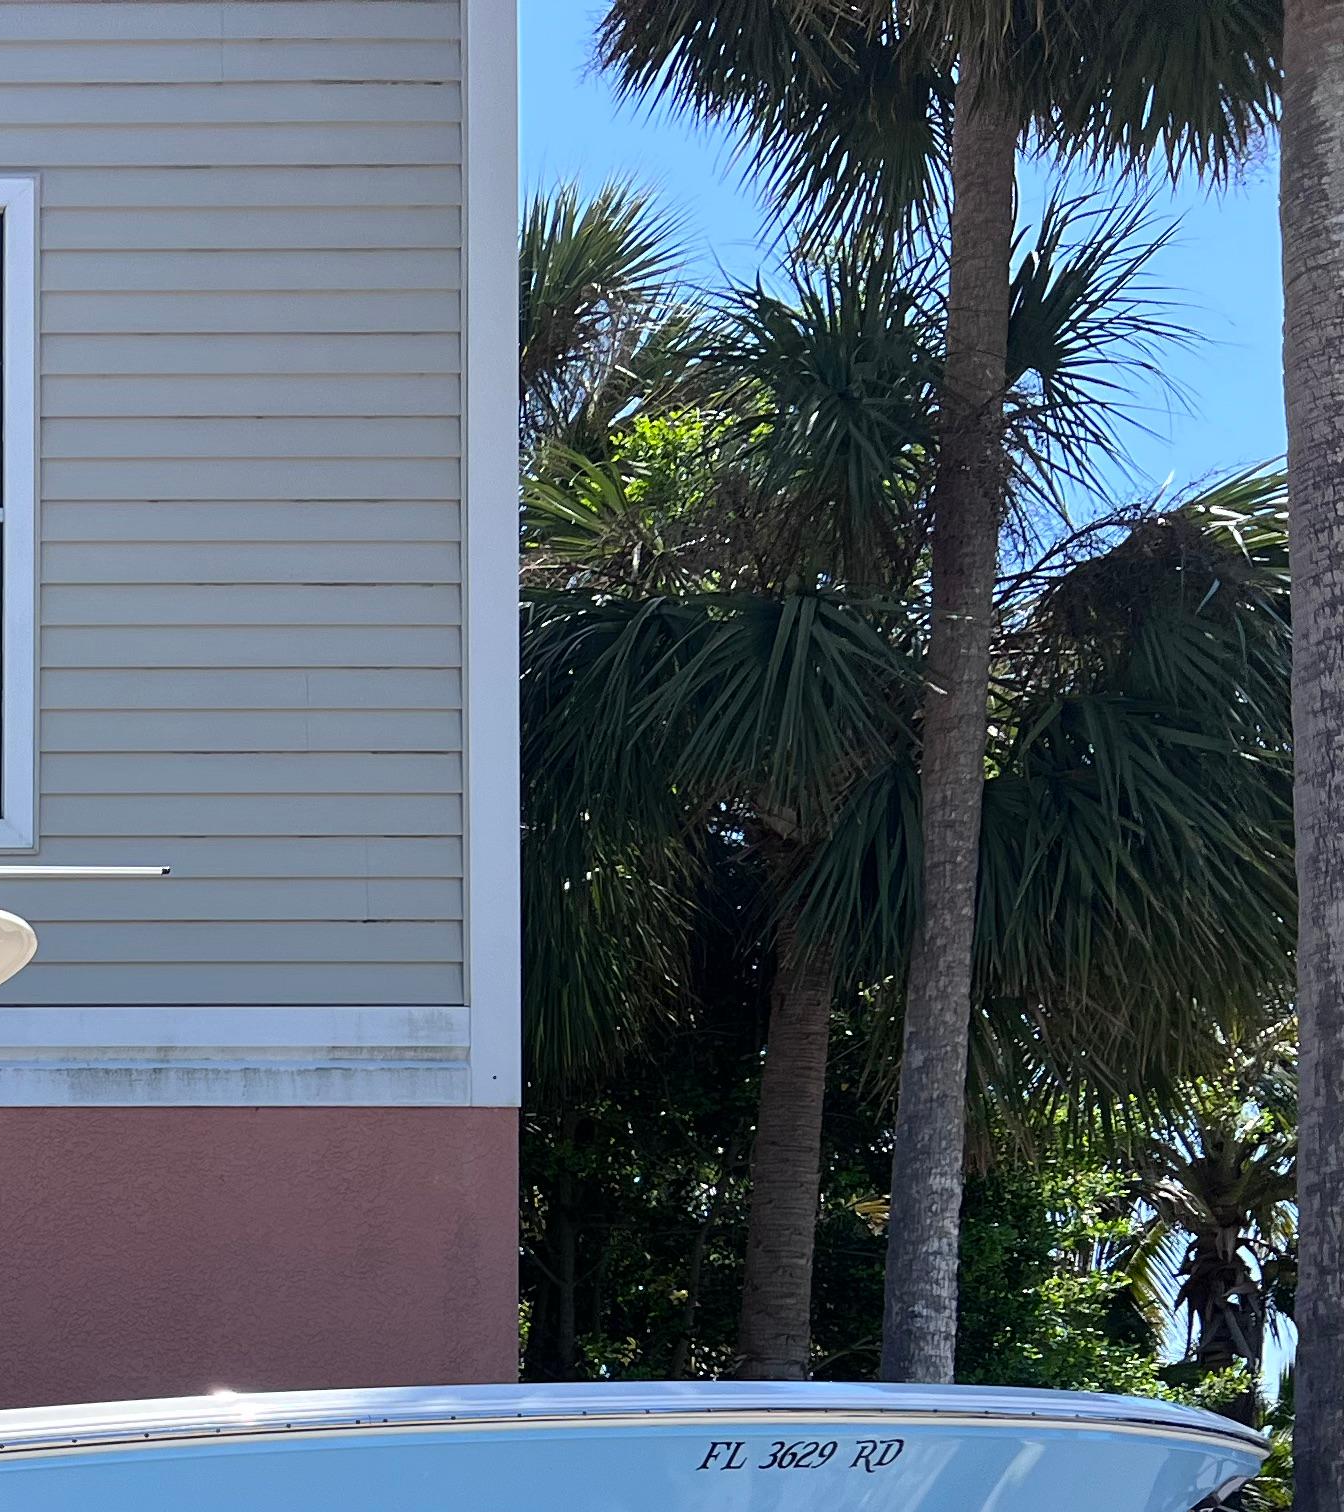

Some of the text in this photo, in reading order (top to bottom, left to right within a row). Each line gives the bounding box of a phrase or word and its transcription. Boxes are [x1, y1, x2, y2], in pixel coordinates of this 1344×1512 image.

[696, 1439, 905, 1473] FL 3629 RD
